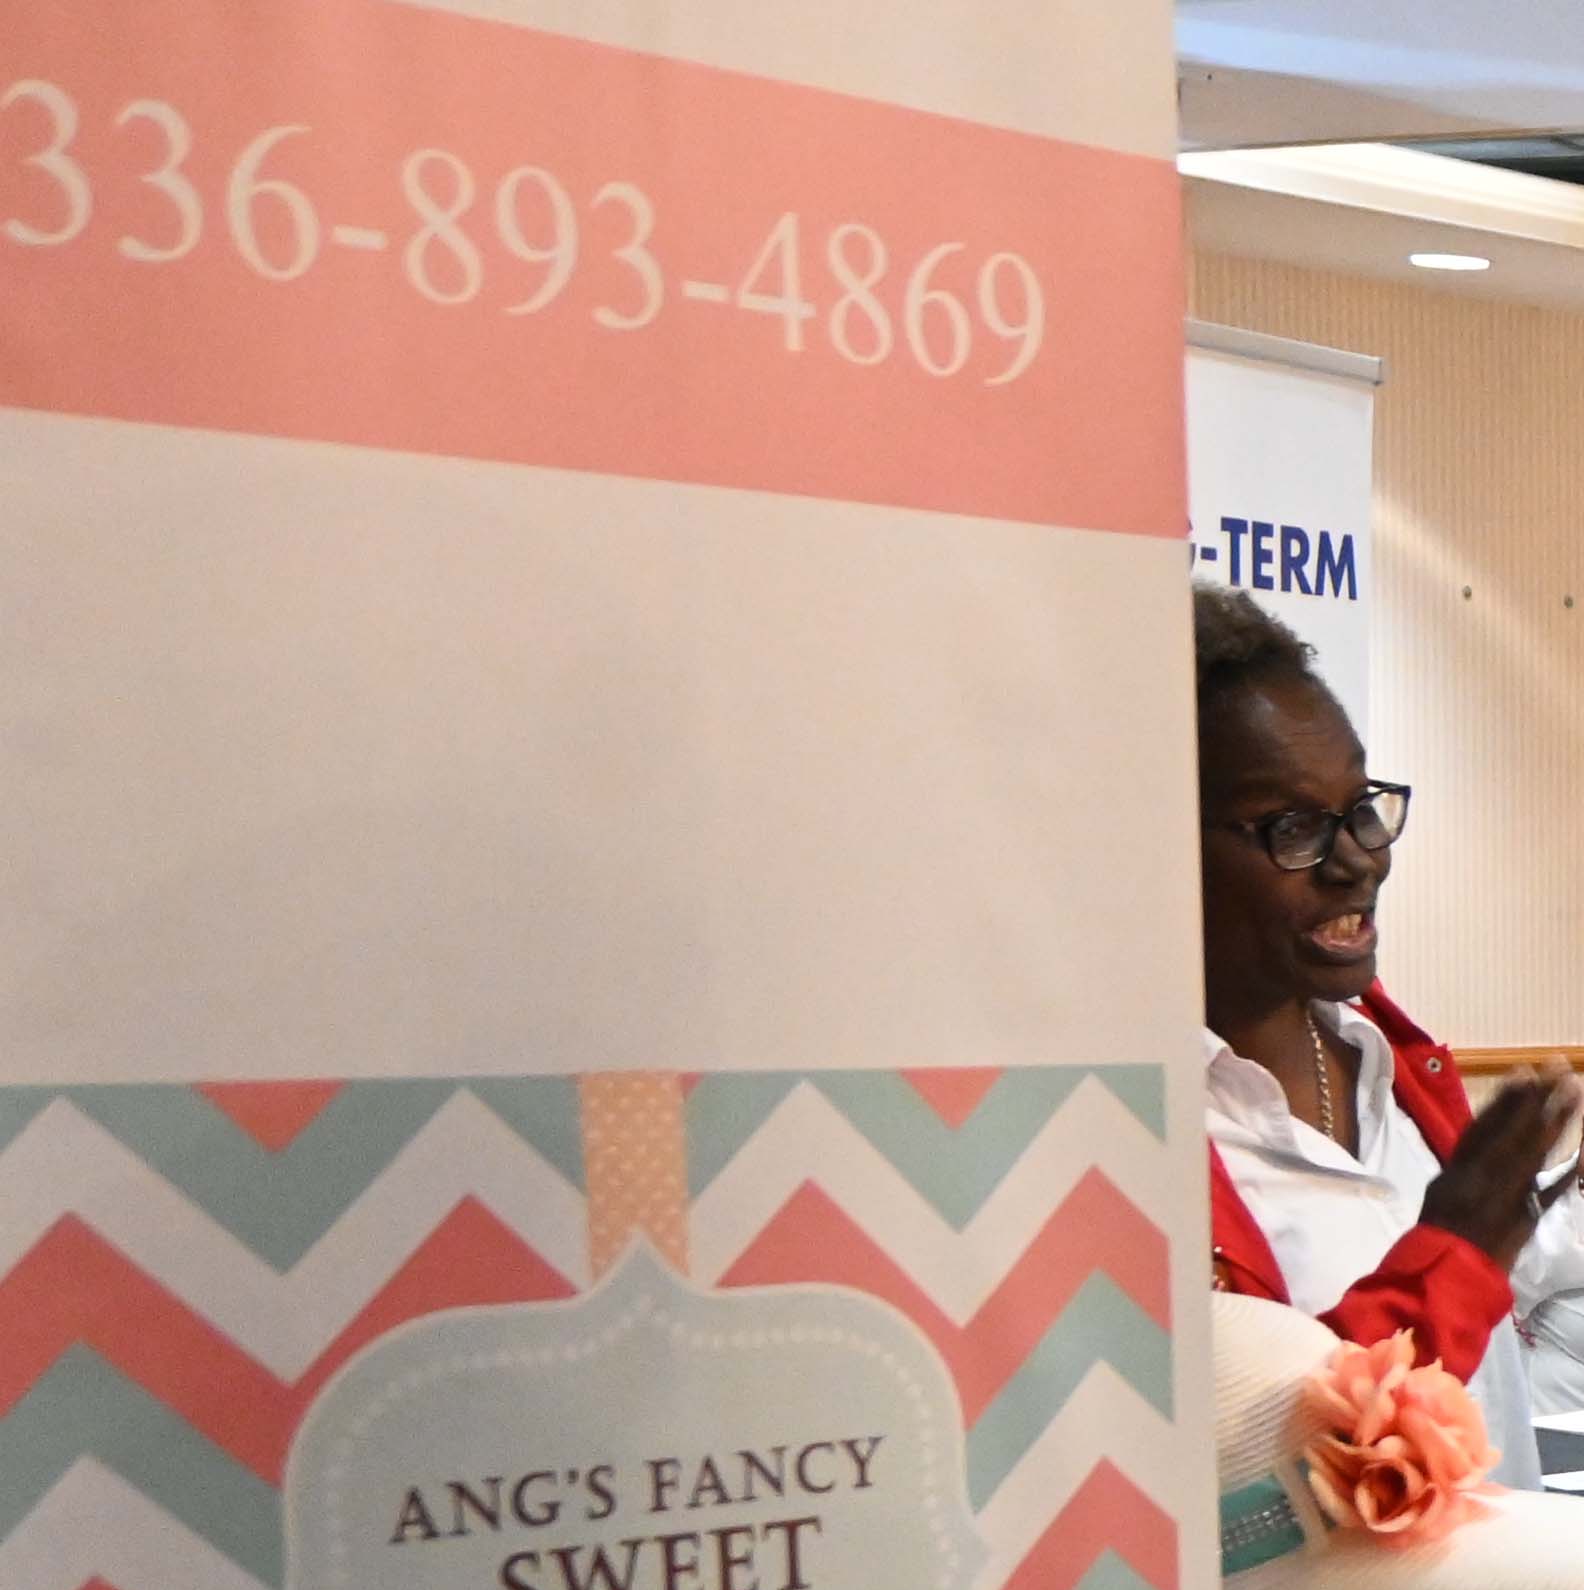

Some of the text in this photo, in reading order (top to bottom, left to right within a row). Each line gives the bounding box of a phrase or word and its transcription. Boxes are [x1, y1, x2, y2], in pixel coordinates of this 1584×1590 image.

[0, 80, 1046, 387] 336-893-4869
[1189, 516, 1358, 600] -TERM
[388, 1436, 886, 1543] ANG'S FANCY
